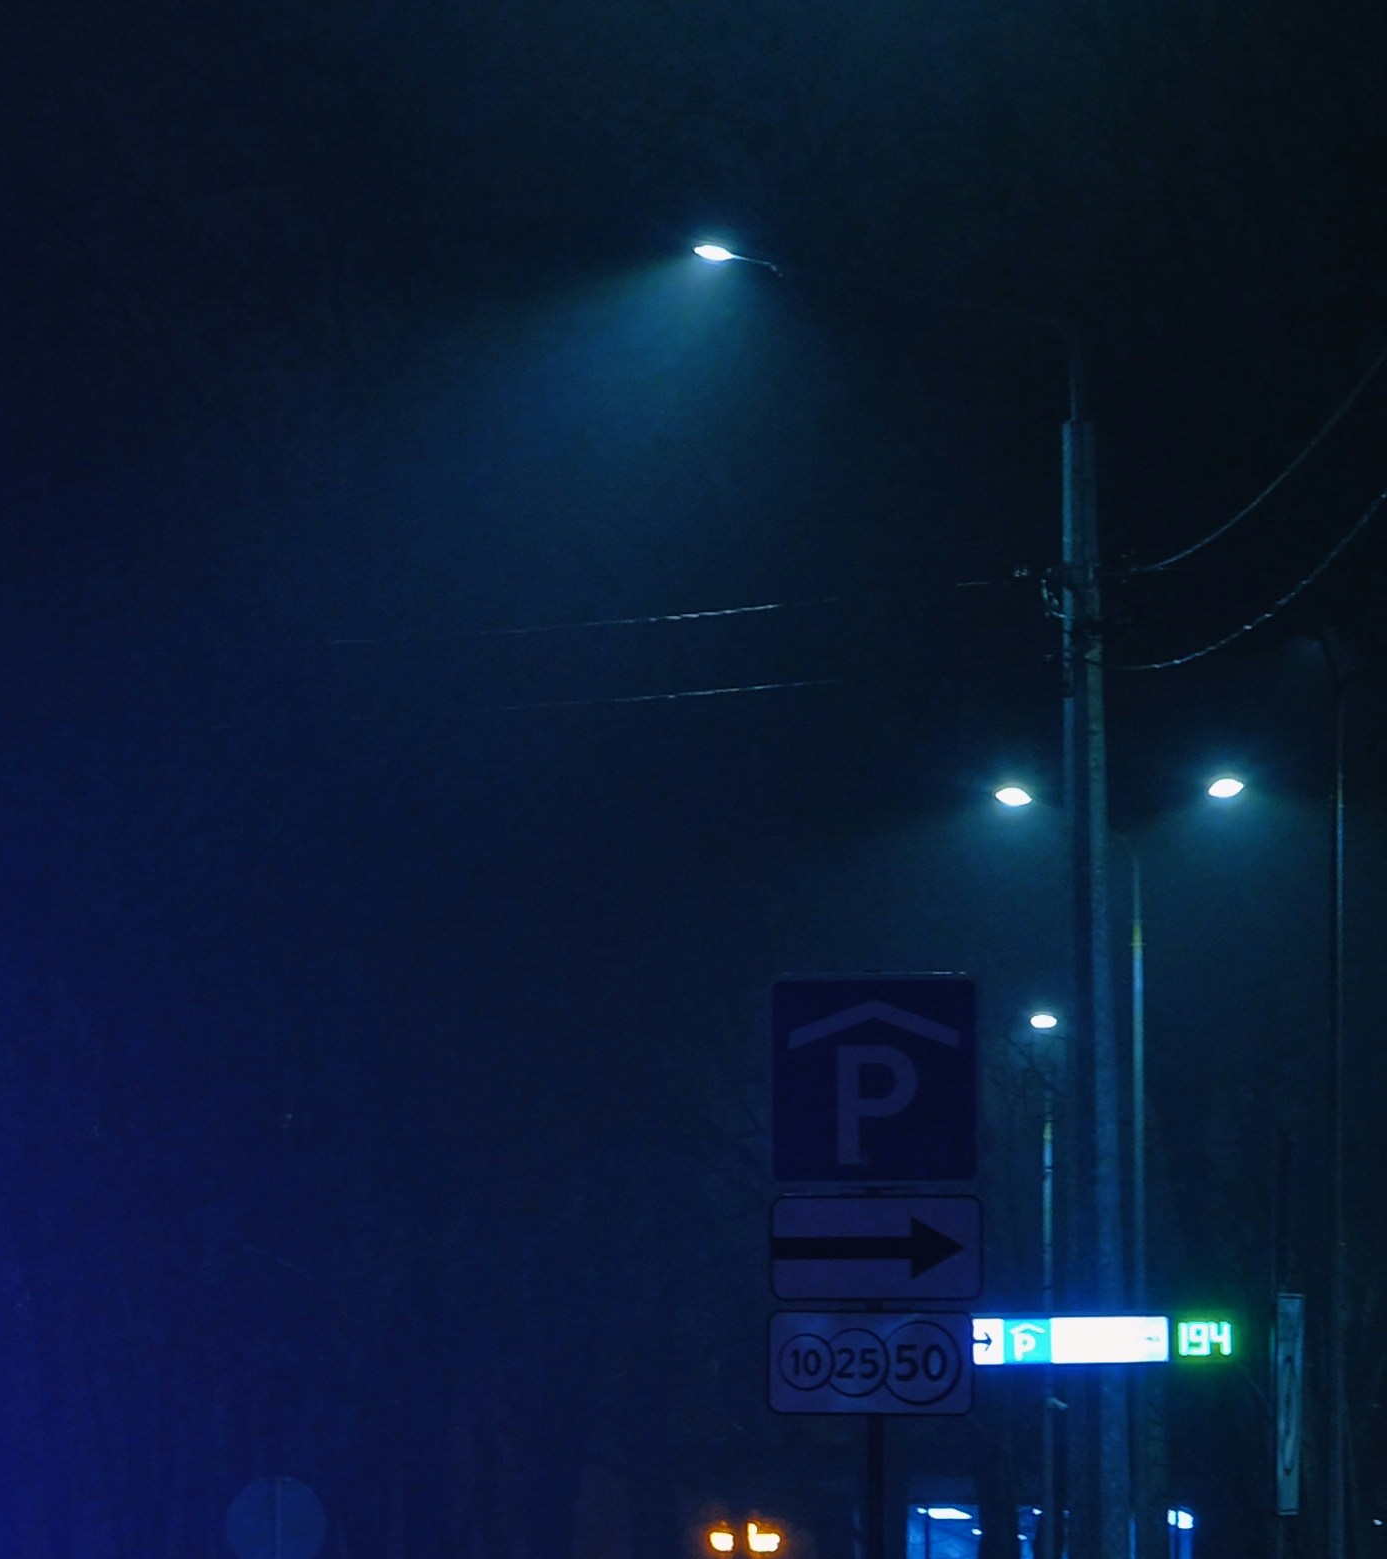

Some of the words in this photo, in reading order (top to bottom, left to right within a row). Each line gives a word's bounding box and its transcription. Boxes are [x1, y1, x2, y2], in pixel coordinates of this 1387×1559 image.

[837, 1044, 918, 1165] P
[1013, 1332, 1037, 1361] P
[1177, 1321, 1231, 1356] 194
[790, 1349, 821, 1376] 10
[836, 1347, 877, 1379] 25
[895, 1344, 946, 1381] 50
